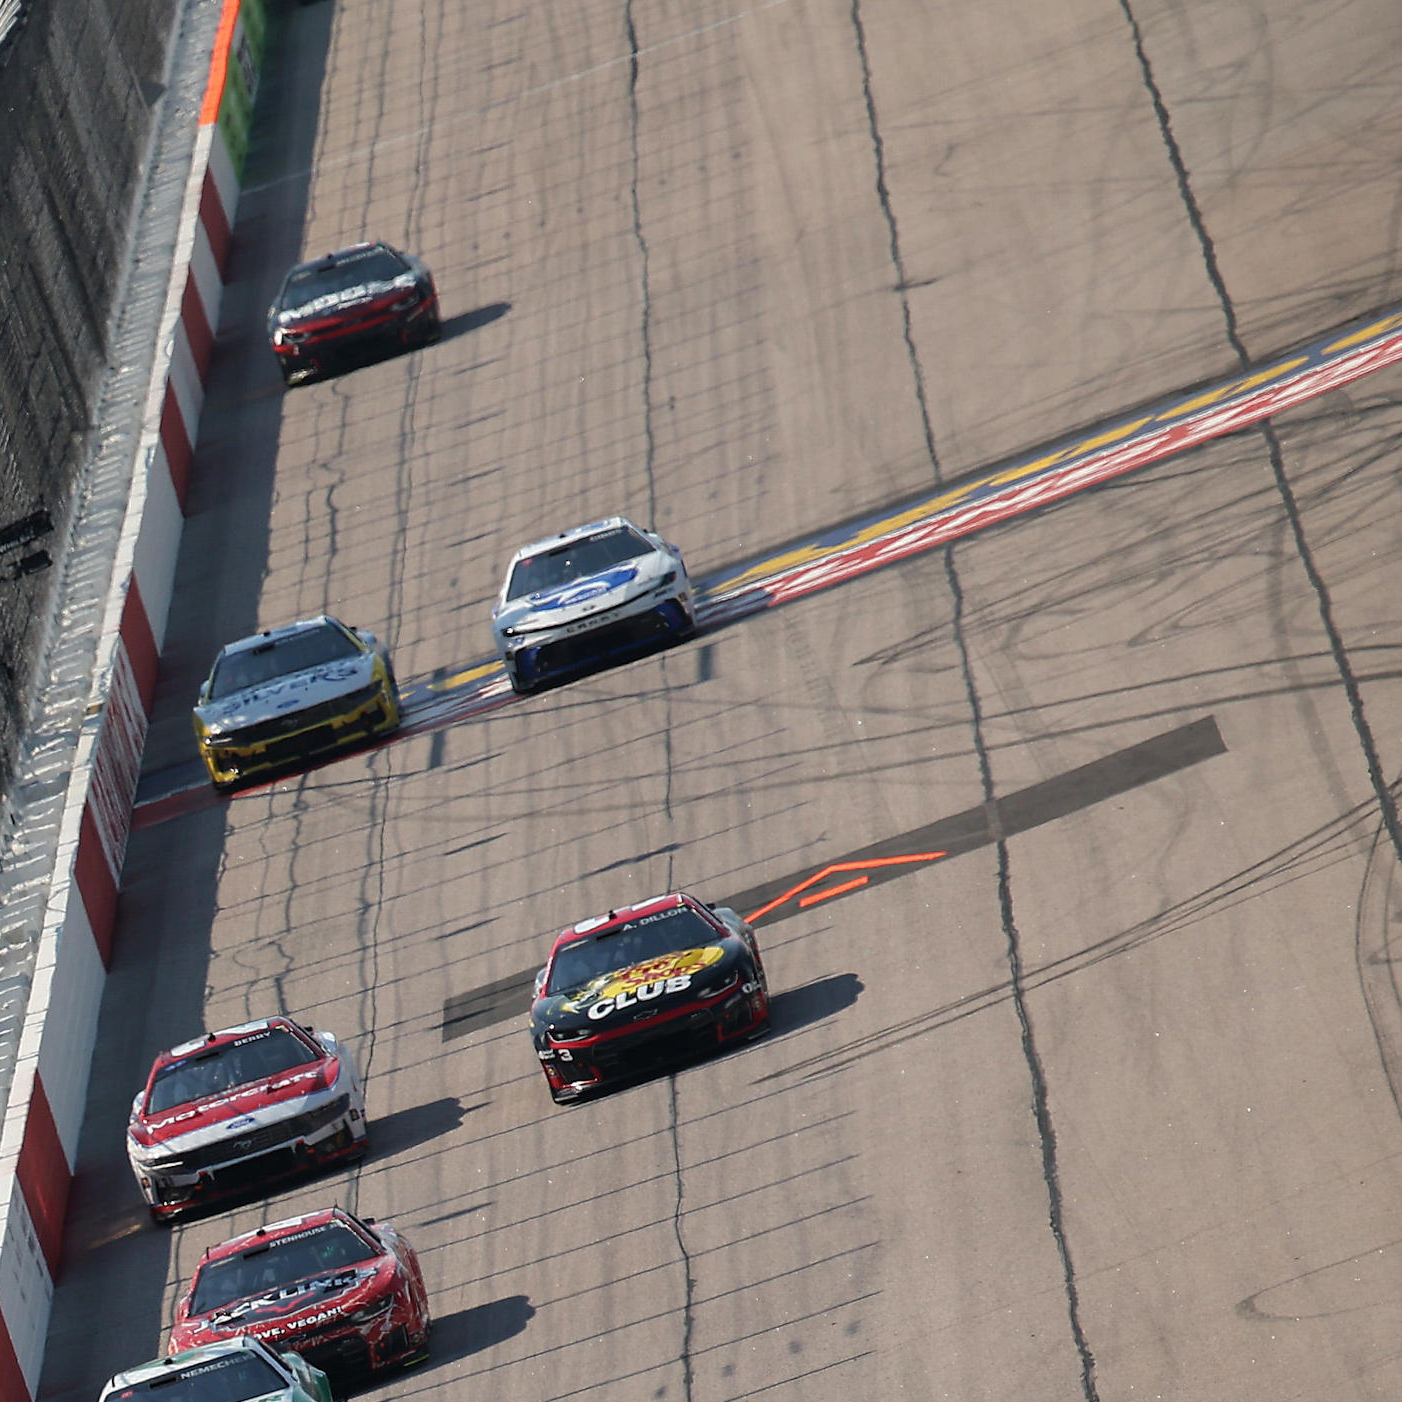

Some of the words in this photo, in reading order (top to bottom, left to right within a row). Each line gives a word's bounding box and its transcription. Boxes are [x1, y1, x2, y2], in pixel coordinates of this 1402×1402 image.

[588, 974, 692, 1020] CLUB
[558, 1049, 573, 1062] 3
[269, 1226, 327, 1248] STENHOUSE
[287, 1307, 343, 1330] VEGAN!
